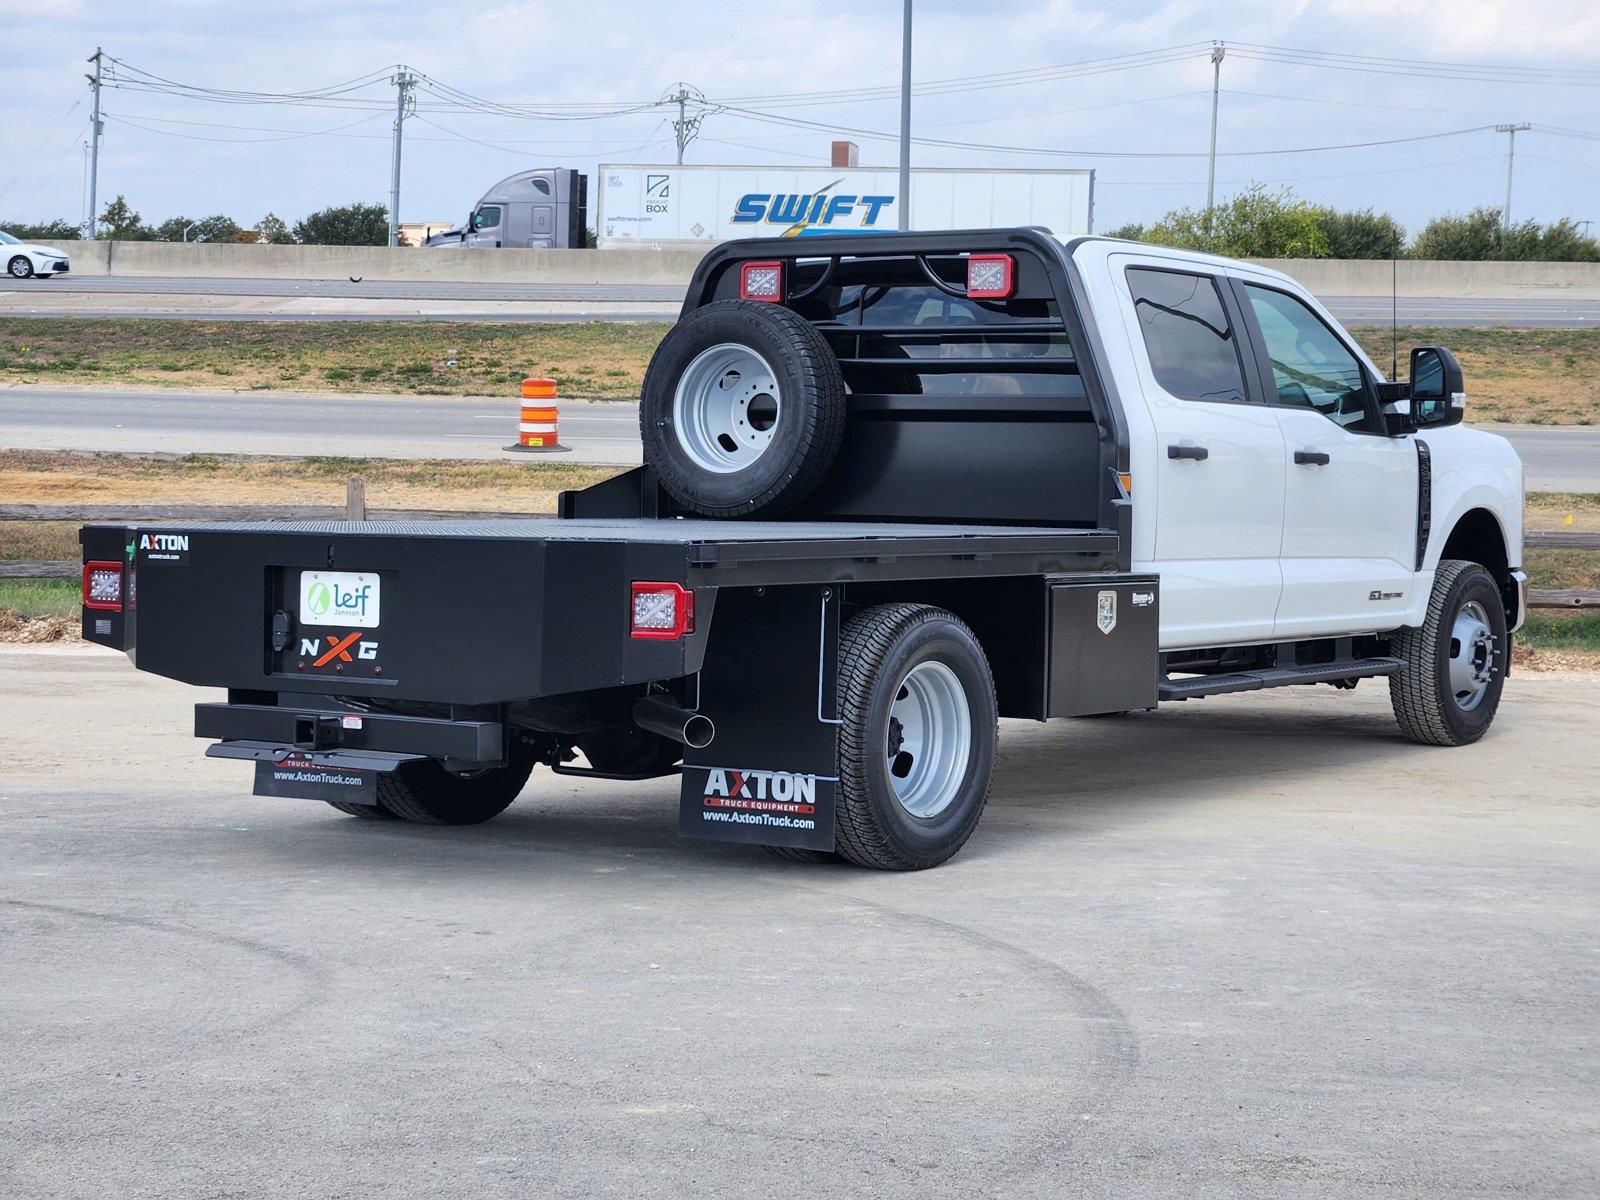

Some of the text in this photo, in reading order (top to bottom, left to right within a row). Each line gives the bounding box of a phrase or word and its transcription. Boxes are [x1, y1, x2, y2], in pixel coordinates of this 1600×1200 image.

[646, 204, 669, 213] BOX
[731, 193, 896, 226] SWIFT
[140, 534, 189, 551] AXTON
[333, 583, 371, 617] leif
[333, 608, 361, 617] Johnson
[286, 760, 311, 768] TRUCK
[273, 771, 363, 786] www.AxtonTruck.com
[703, 767, 816, 805] AXTON
[719, 799, 800, 812] TRUCK EQUIPMENT
[702, 811, 816, 830] www.AxtonTruck.com
